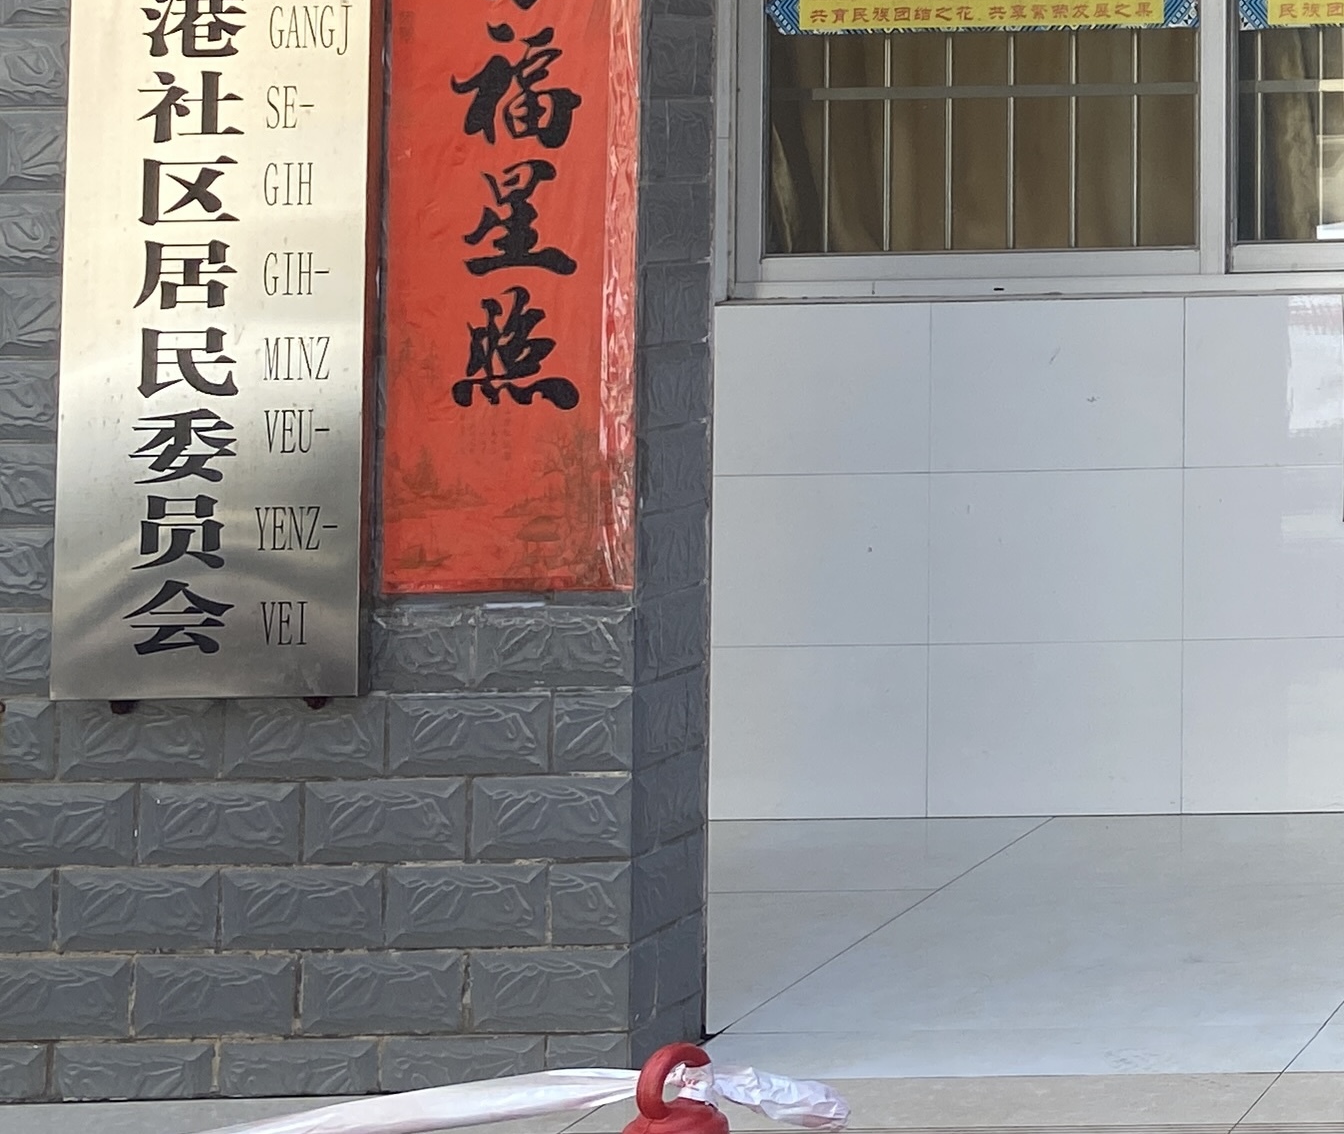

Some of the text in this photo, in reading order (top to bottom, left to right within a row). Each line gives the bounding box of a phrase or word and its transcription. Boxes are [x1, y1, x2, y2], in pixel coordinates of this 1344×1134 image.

[269, 4, 351, 55] GANGJ
[810, 2, 1153, 24] 共育民族团结之花 共享繁荣发展之果
[263, 163, 314, 206] GIH
[263, 336, 331, 381] MINZ
[260, 601, 308, 646] VEI
